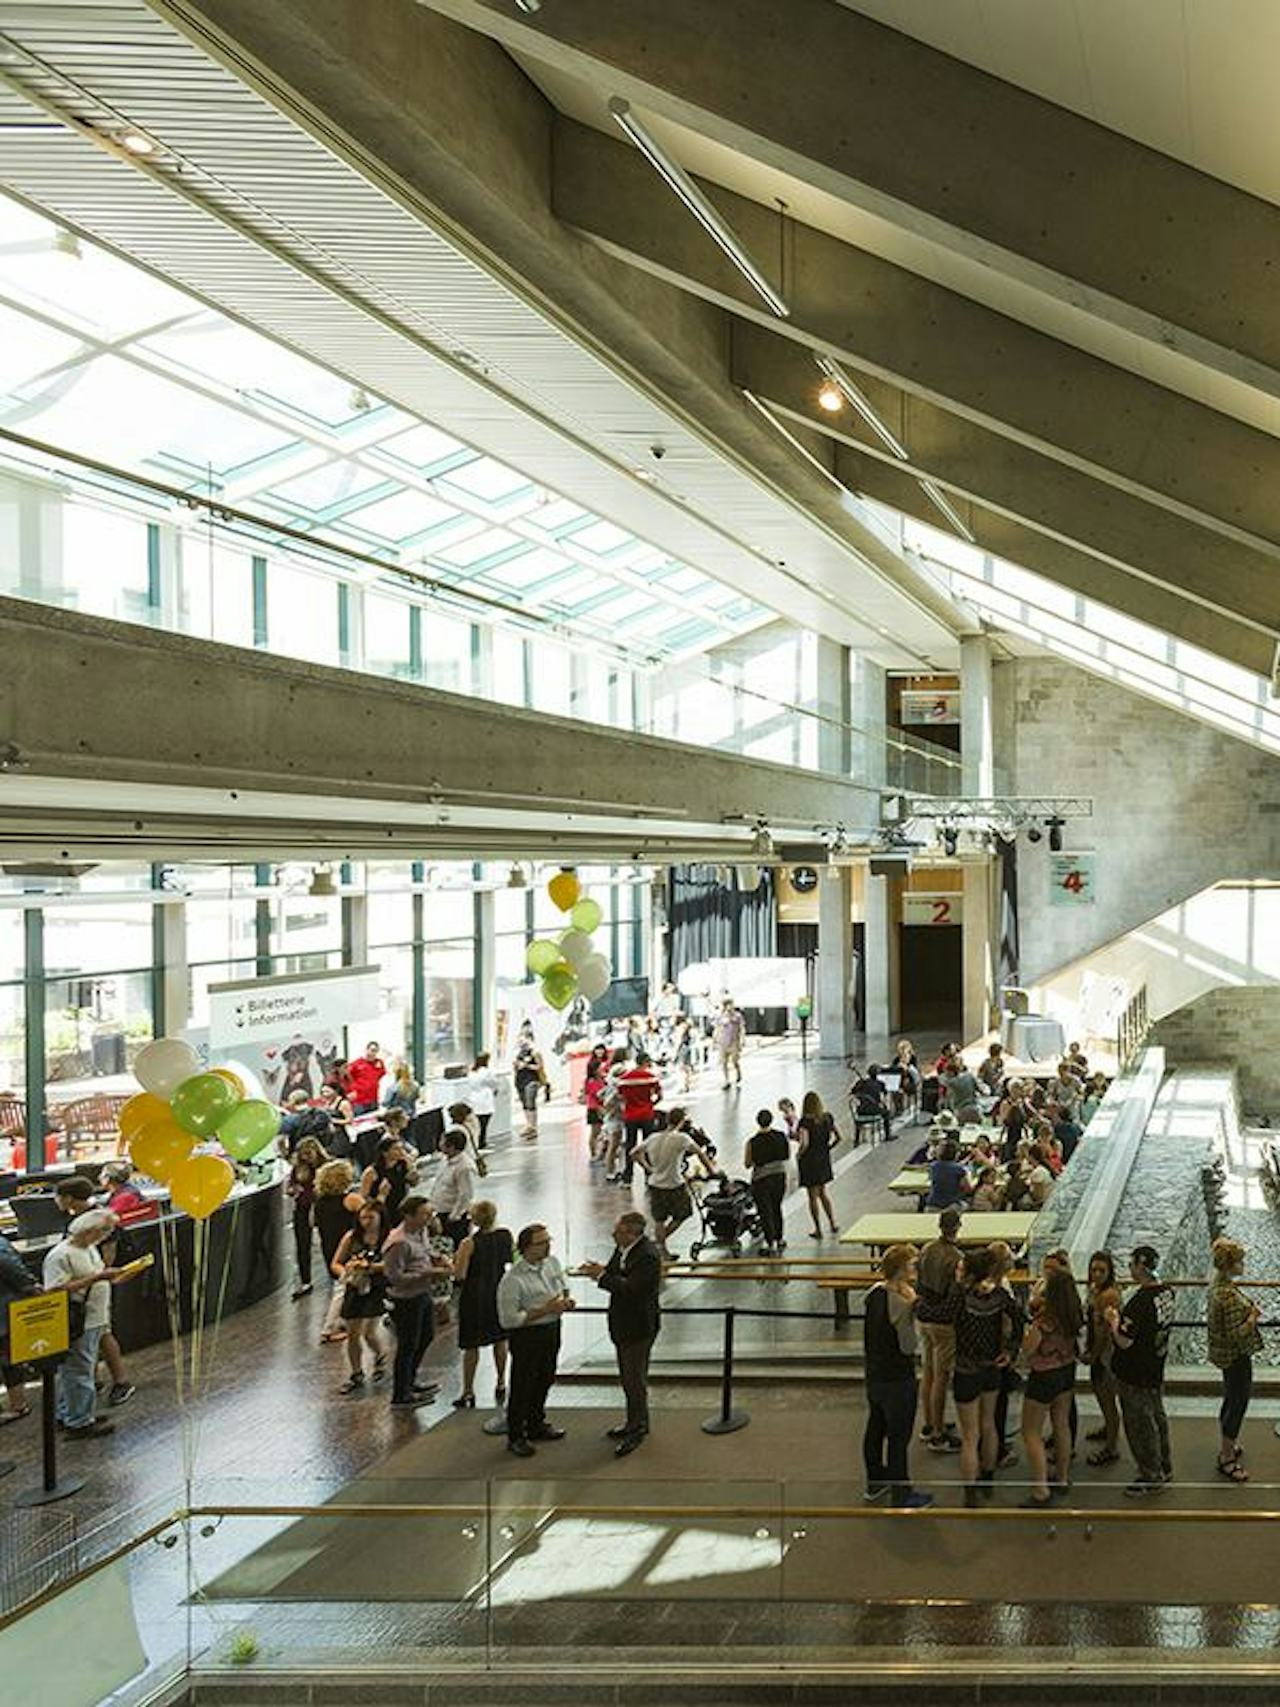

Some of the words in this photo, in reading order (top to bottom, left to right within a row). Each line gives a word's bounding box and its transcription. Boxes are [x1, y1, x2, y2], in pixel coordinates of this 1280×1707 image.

[933, 901, 951, 923] 2
[248, 996, 305, 1012] Billetterie
[248, 1008, 318, 1026] Information
